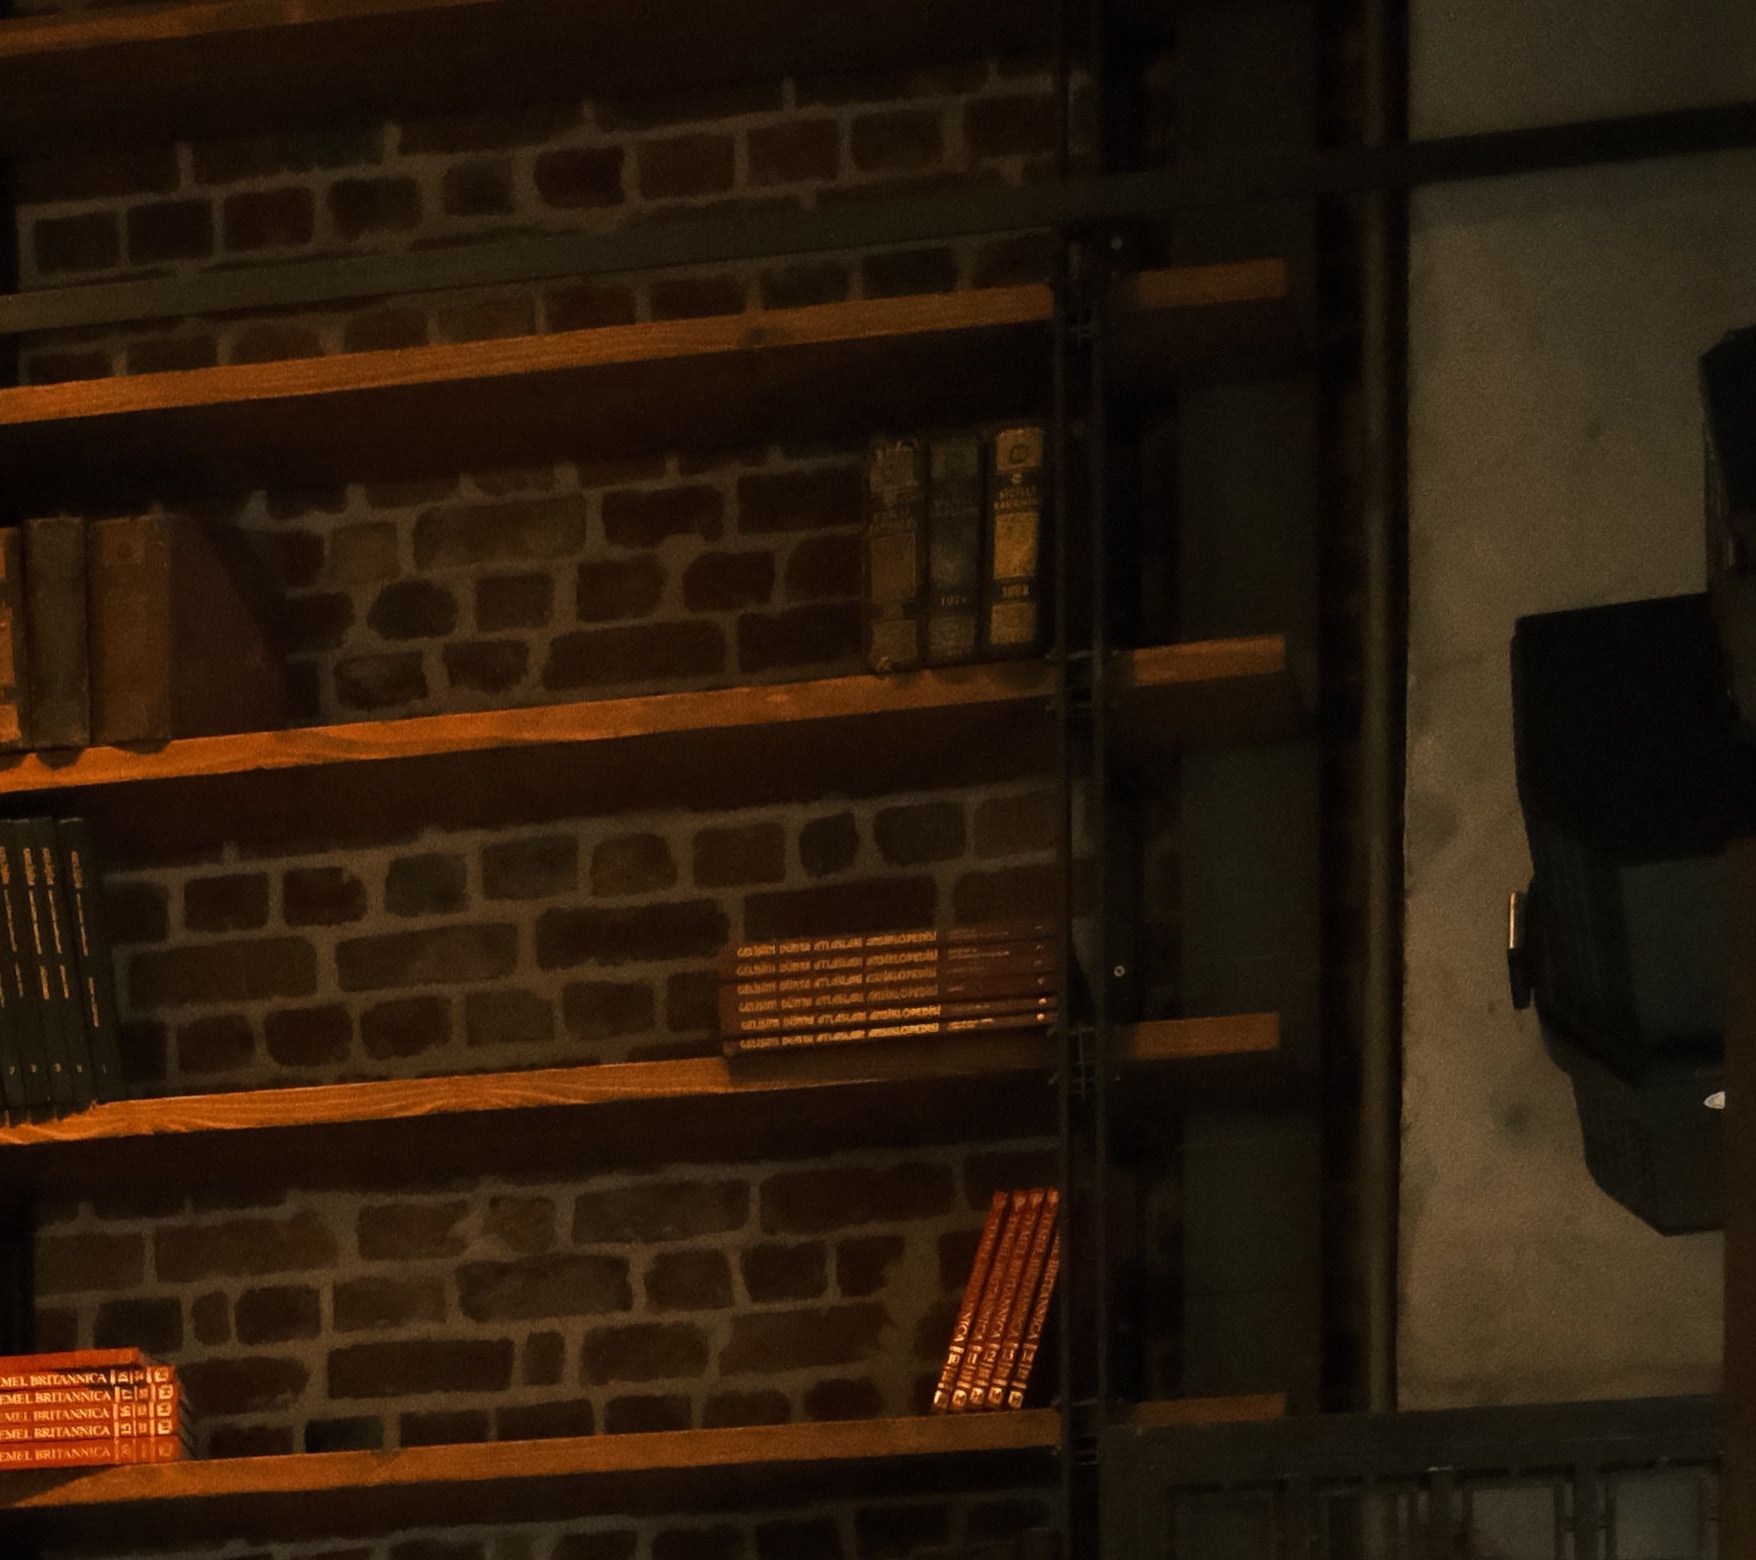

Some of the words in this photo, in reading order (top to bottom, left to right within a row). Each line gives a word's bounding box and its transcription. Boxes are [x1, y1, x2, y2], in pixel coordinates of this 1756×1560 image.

[30, 1372, 108, 1383] BRITANNICA
[35, 1391, 112, 1403] BRITANNICA
[33, 1408, 110, 1421] BRITANNICA
[34, 1425, 111, 1438] BRITANNICA
[35, 1446, 111, 1461] BRITANNICA
